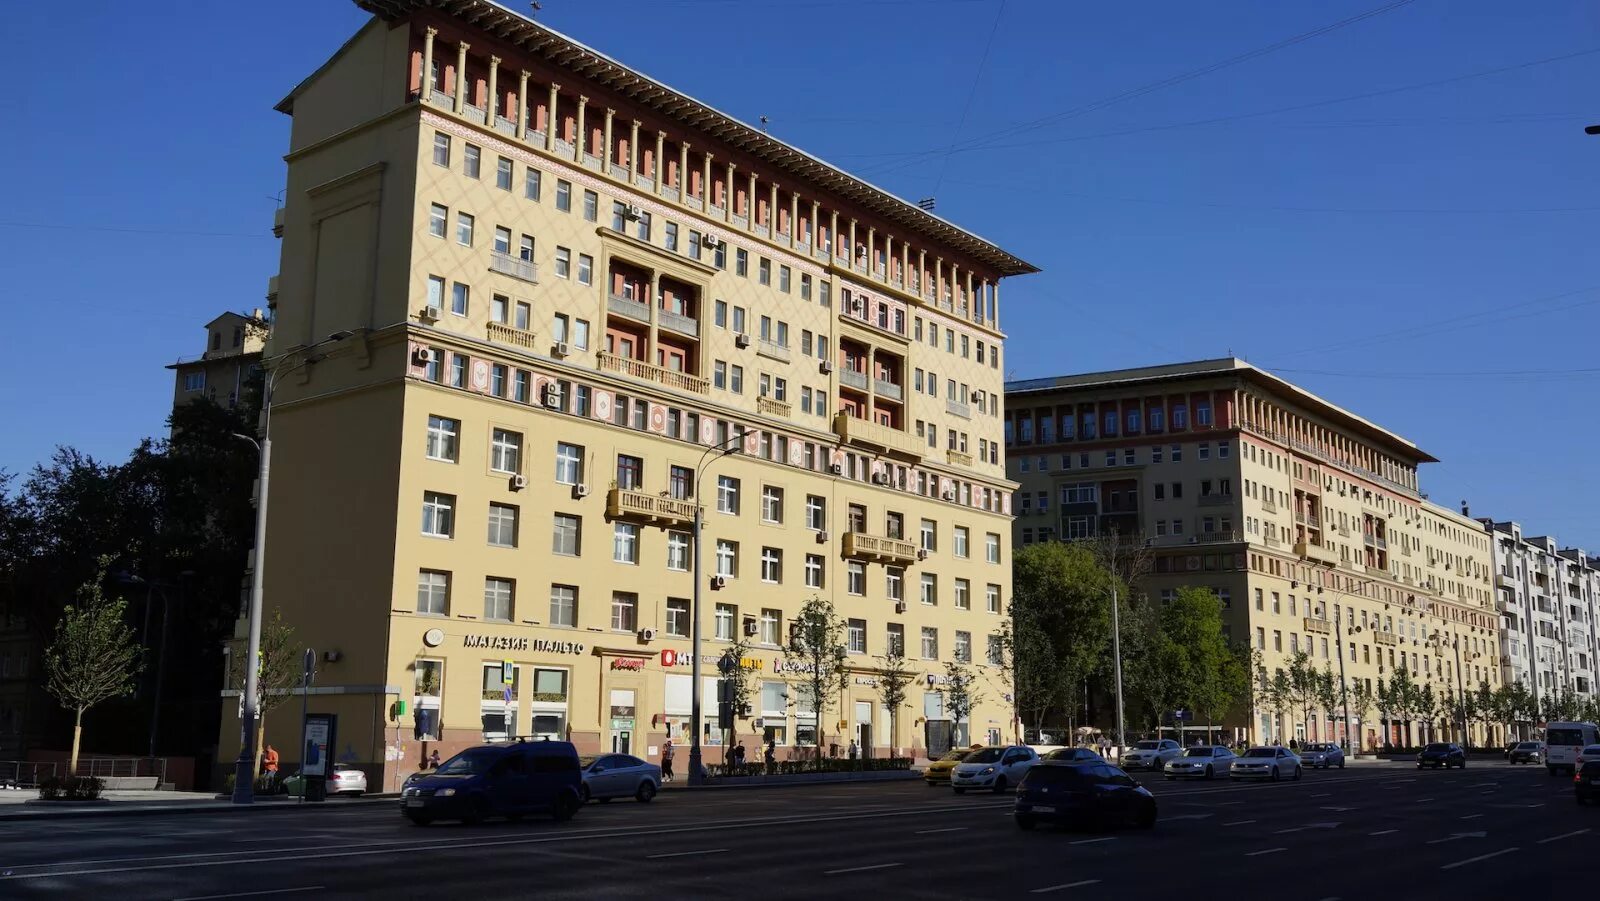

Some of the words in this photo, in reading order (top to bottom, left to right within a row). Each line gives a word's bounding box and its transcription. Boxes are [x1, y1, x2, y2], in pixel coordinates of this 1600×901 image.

[465, 634, 528, 650] МАГАЗИН
[535, 639, 585, 654] ПАЛЬТО
[676, 652, 699, 665] МТ
